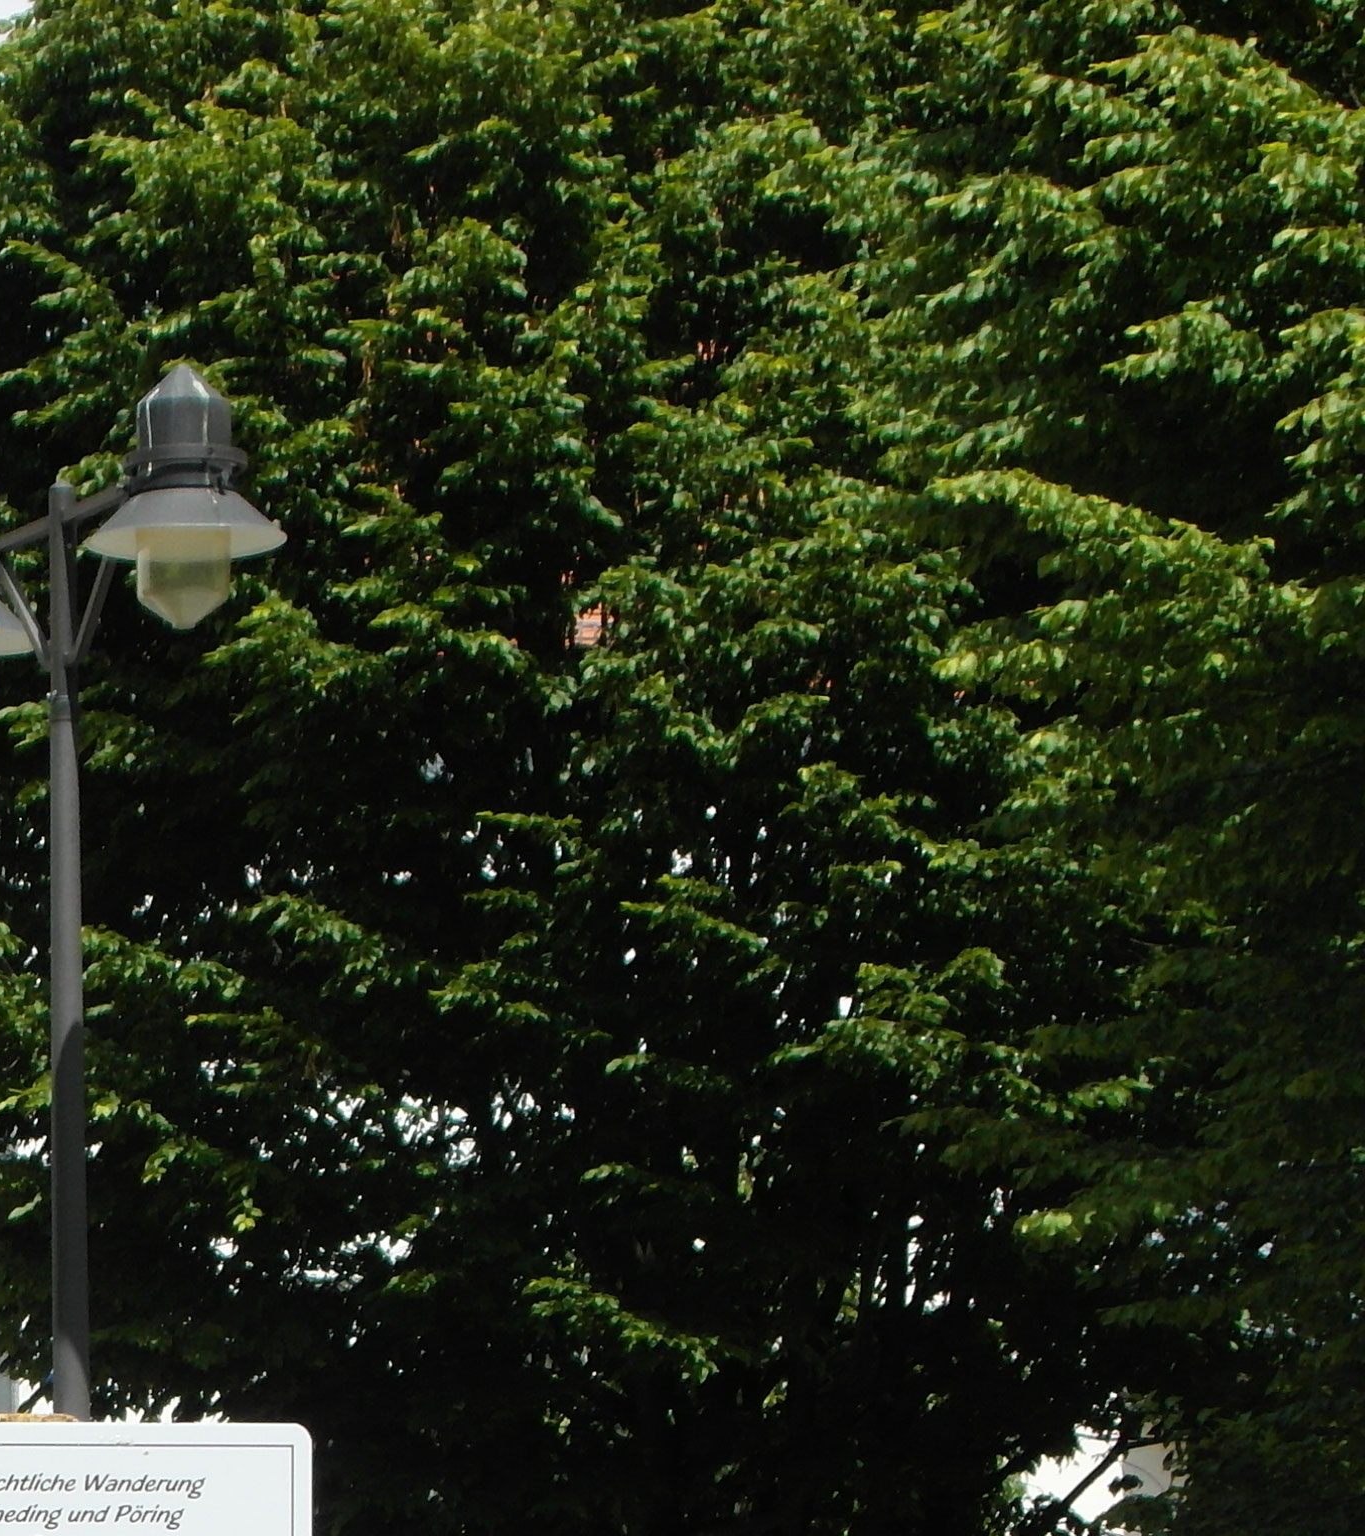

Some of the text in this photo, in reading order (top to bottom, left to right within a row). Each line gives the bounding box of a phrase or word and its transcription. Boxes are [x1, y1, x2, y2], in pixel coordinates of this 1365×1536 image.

[84, 1473, 206, 1500] Wanderung
[67, 1504, 112, 1523] und
[113, 1504, 185, 1531] Pöring
